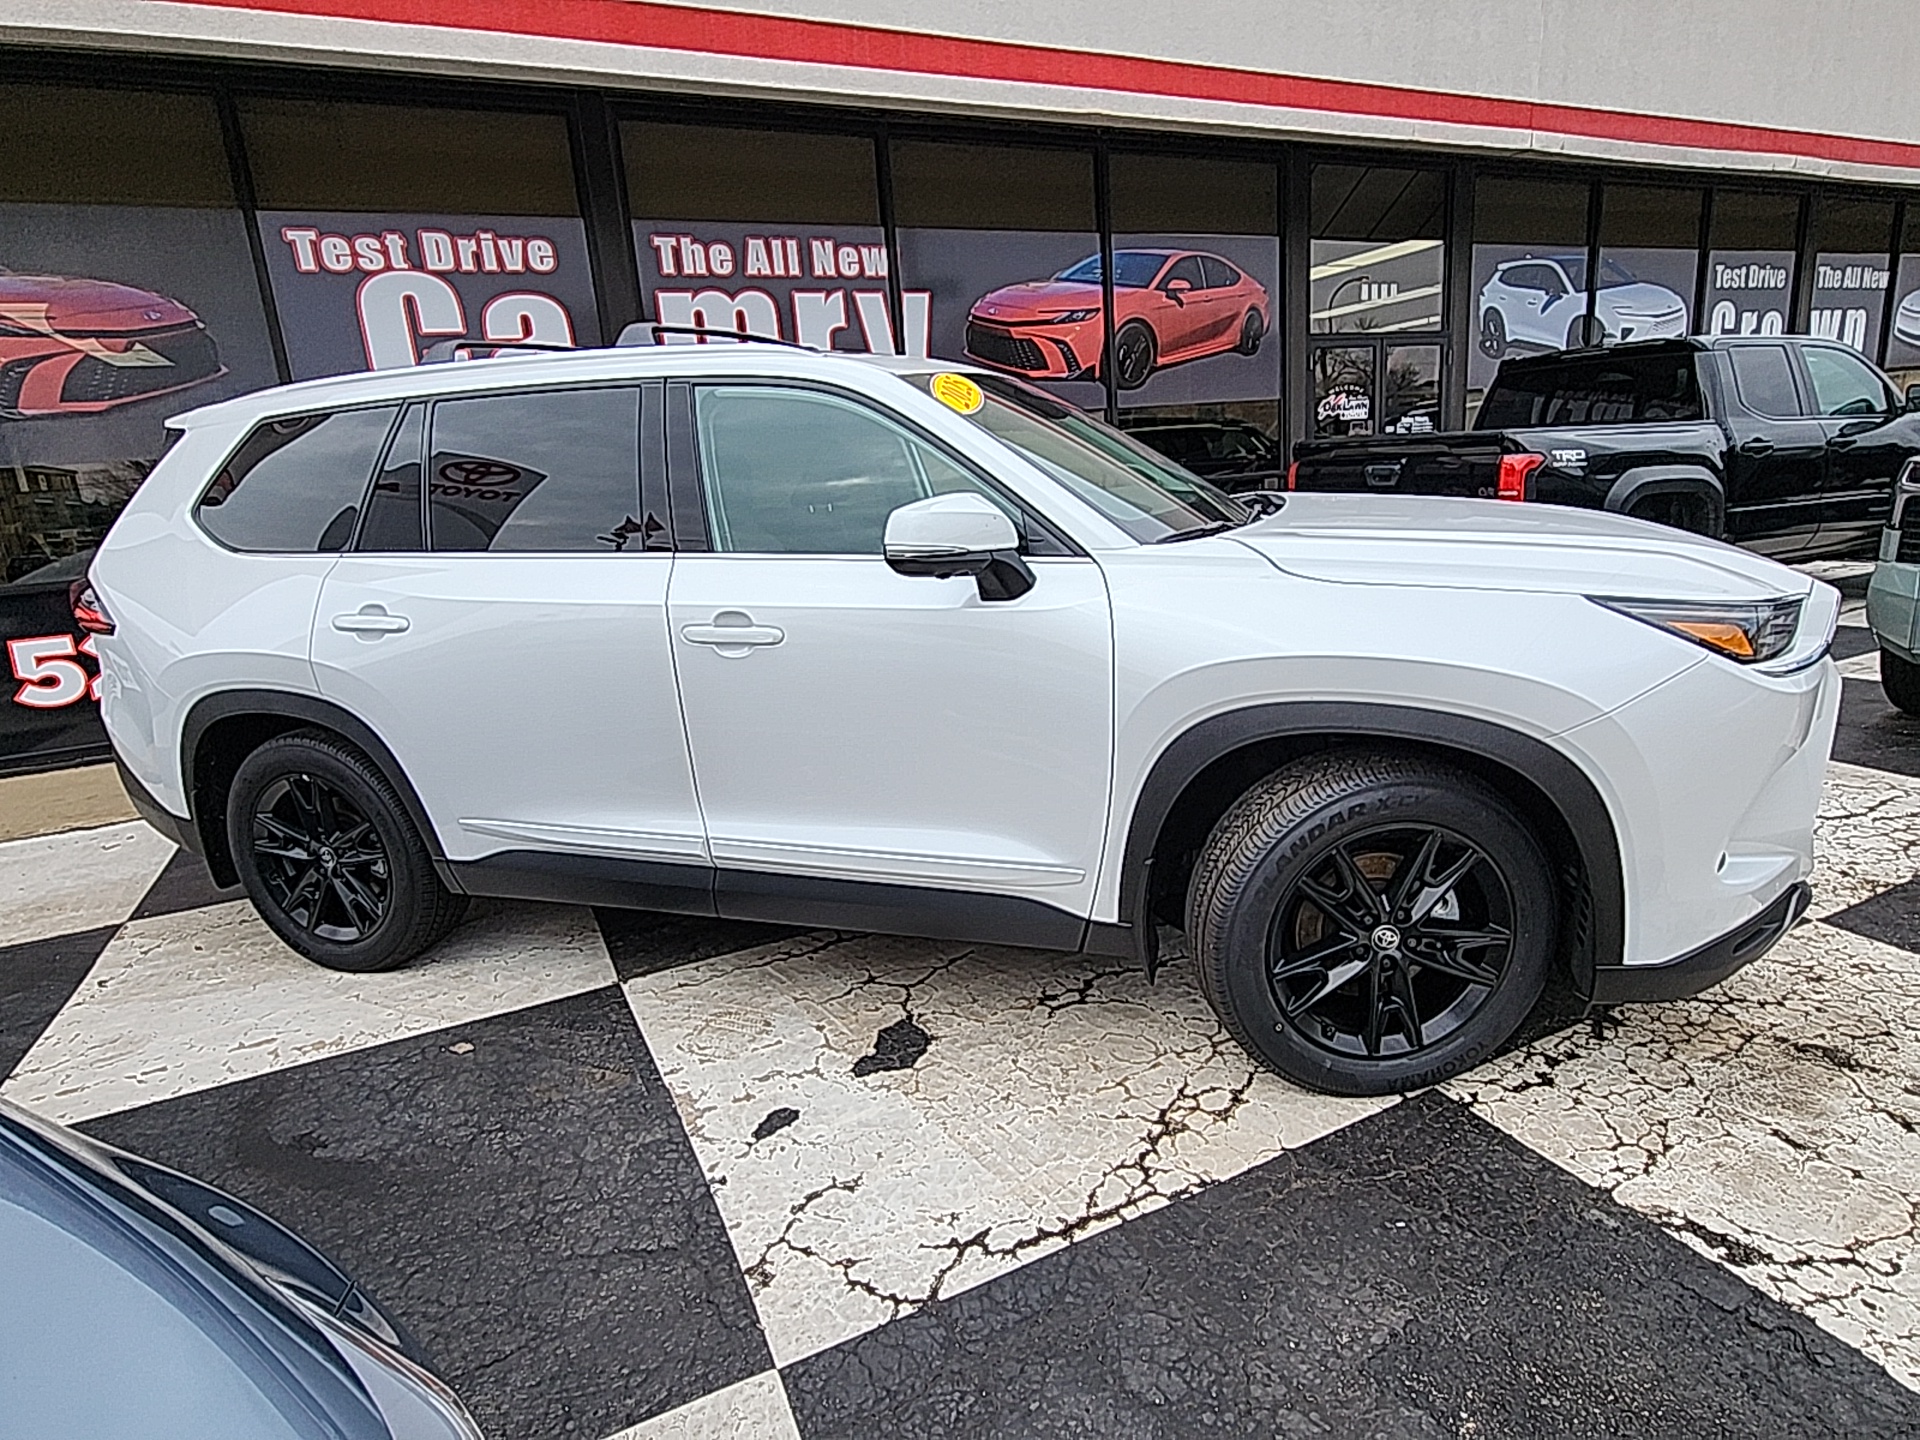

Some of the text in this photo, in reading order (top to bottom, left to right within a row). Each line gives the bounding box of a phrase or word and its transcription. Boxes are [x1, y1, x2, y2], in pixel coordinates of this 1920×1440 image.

[283, 227, 557, 273] Test Drive
[651, 234, 888, 279] The All New
[1715, 264, 1787, 289] Test Drive
[1817, 265, 1890, 289] The All New
[1551, 449, 1586, 462] TRD
